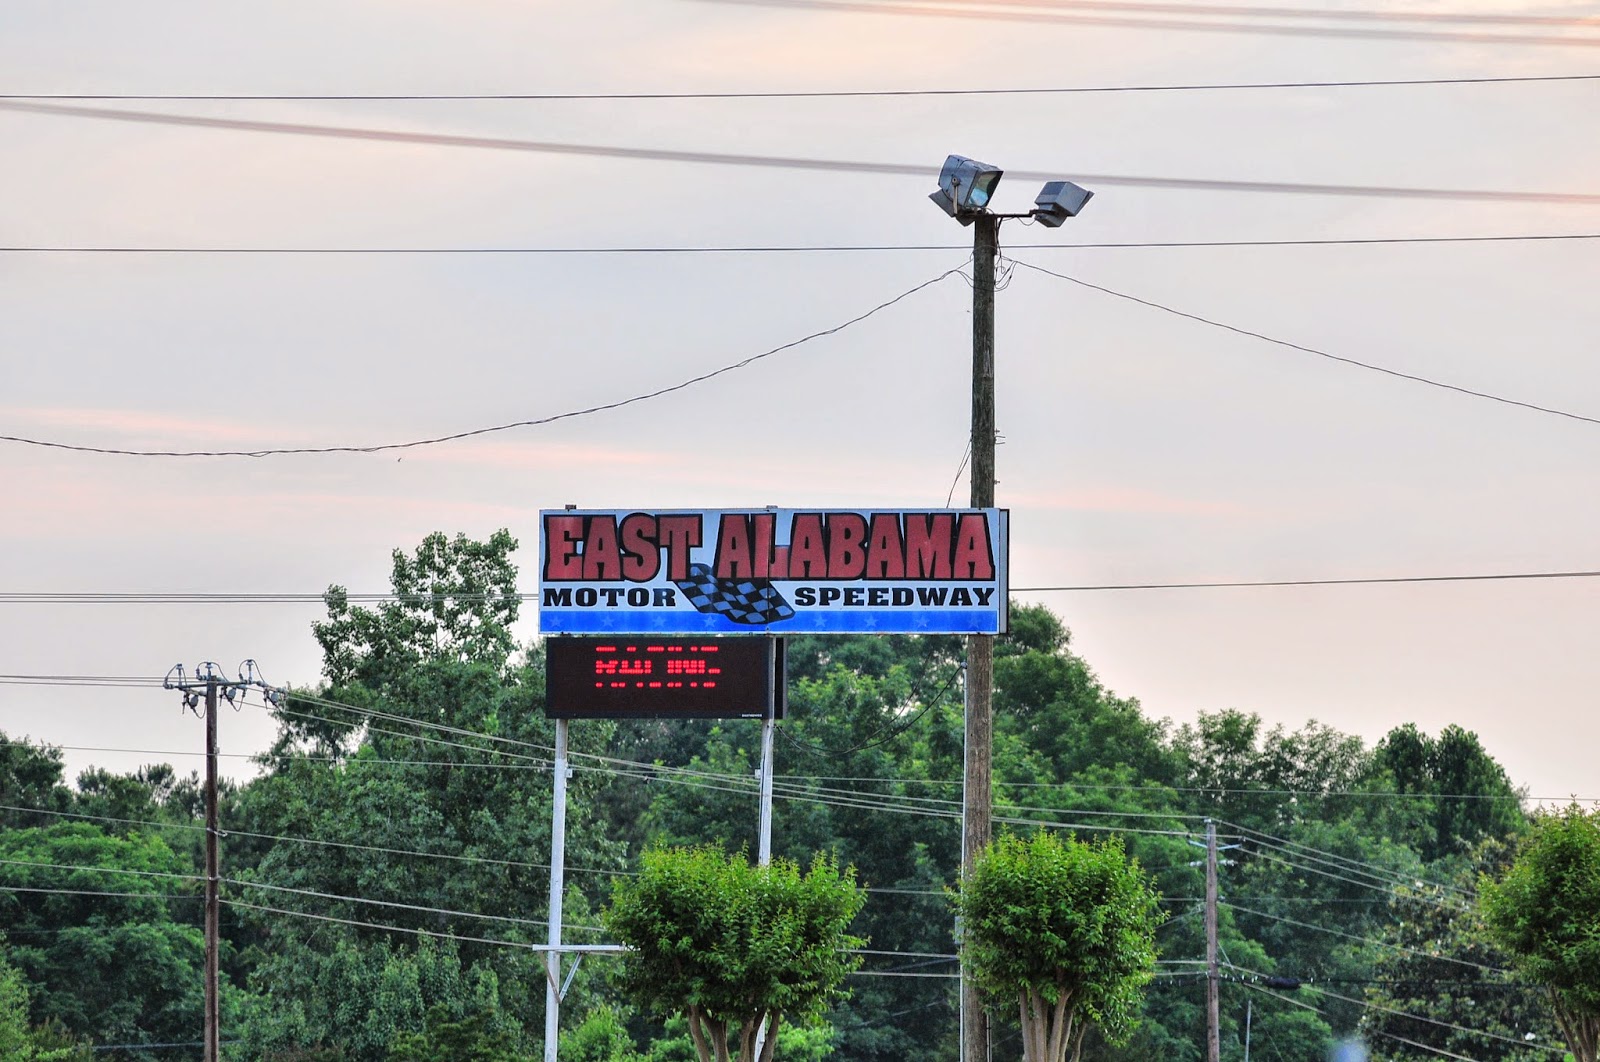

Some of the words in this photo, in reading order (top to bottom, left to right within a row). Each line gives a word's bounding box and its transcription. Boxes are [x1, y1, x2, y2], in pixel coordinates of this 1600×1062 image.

[543, 512, 703, 582] EAST
[712, 512, 995, 582] ALABAMA
[543, 588, 676, 607] MOTOR
[794, 587, 995, 606] SPEEDWAY
